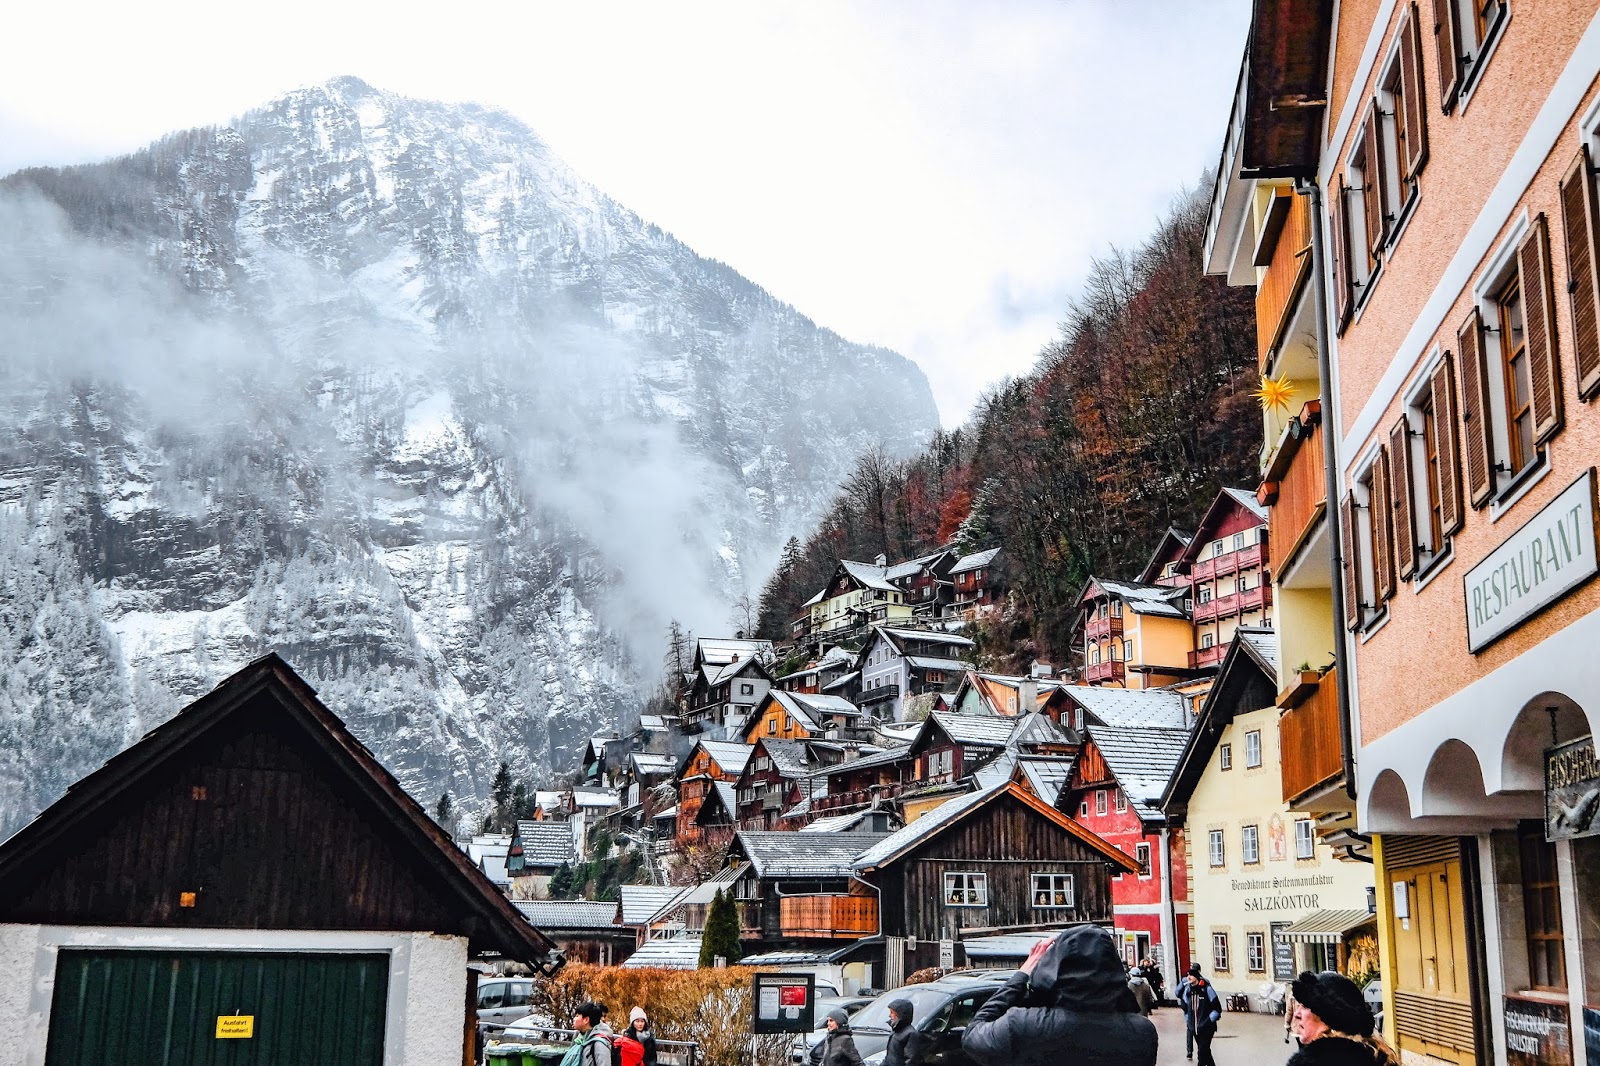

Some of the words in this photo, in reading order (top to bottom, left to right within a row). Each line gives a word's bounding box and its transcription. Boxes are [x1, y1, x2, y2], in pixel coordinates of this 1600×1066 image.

[1472, 503, 1582, 628] RESTAURANT
[1231, 879, 1271, 891] Benediktiner
[1272, 874, 1334, 889] Seifenmanufaktur
[1244, 893, 1320, 912] SALZKONTOR
[1507, 1031, 1539, 1056] HALLSTATT
